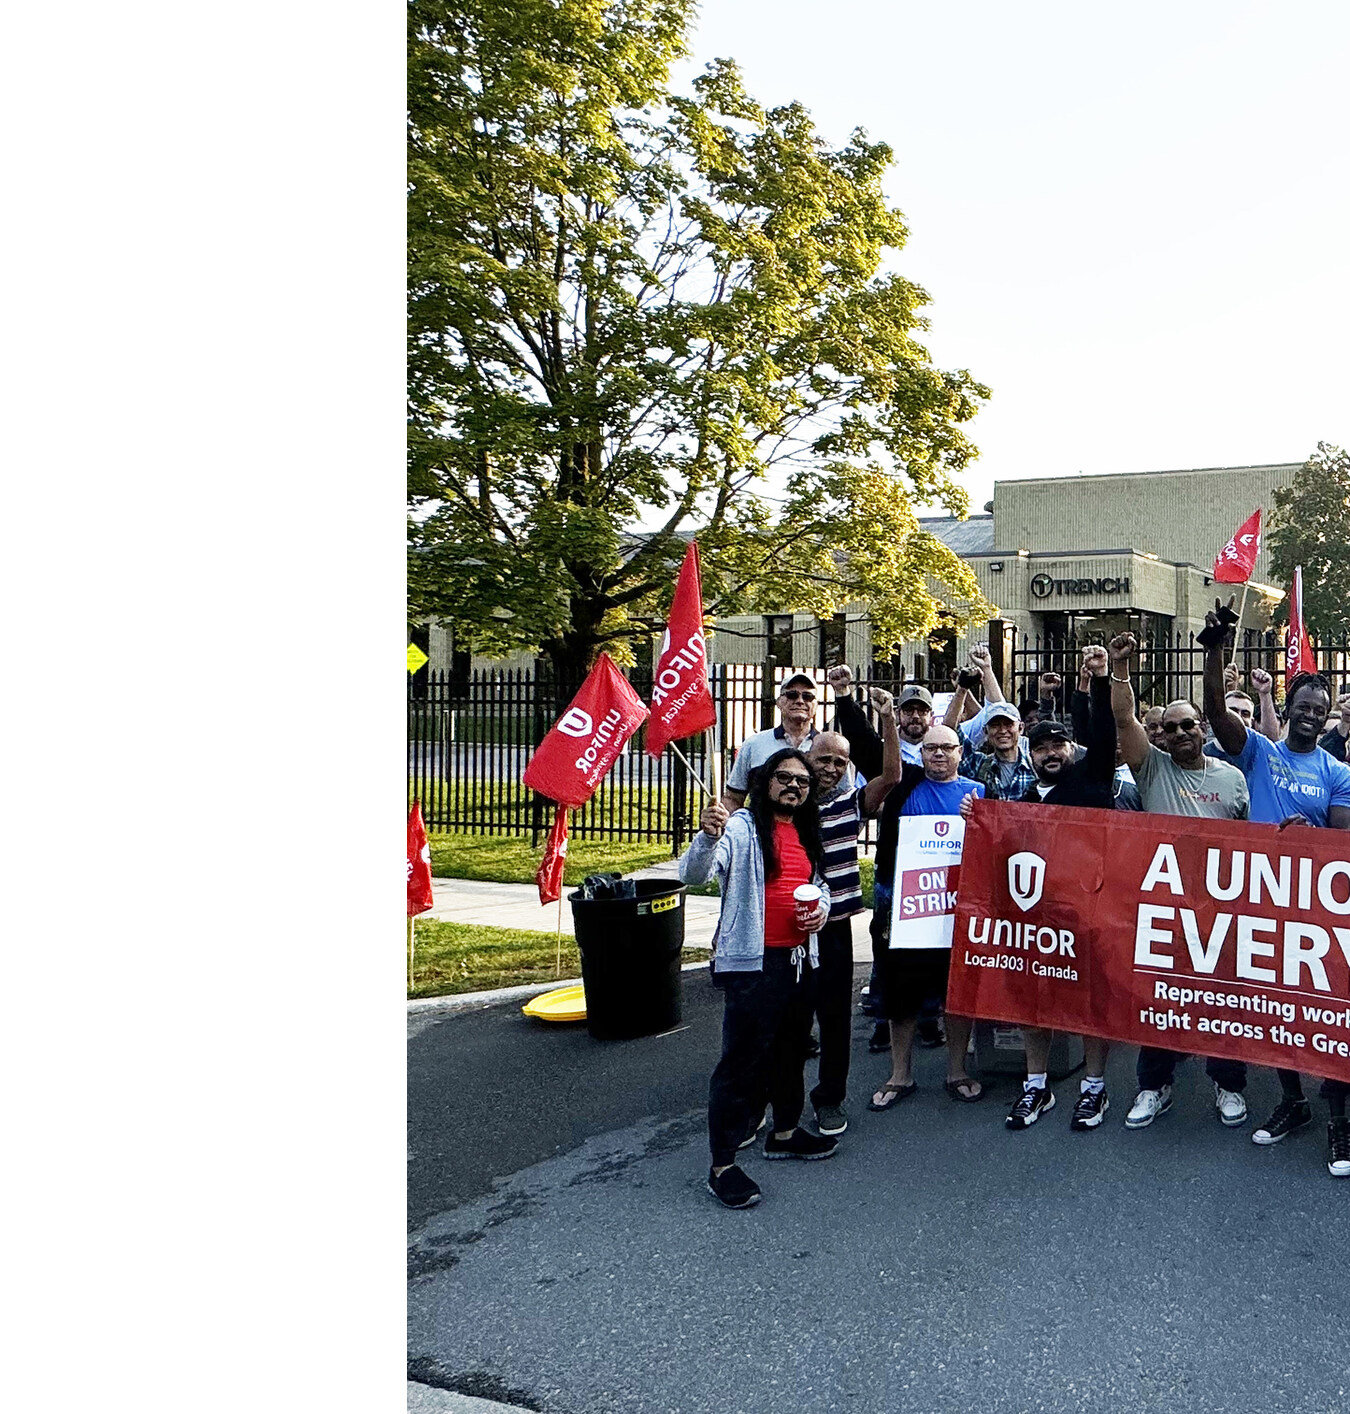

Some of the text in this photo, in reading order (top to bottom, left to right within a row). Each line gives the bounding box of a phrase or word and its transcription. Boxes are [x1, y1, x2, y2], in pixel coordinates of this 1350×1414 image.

[1054, 577, 1129, 595] TRENCH
[918, 871, 946, 891] ON
[1140, 843, 1184, 895] A
[902, 891, 958, 915] STRIK
[964, 951, 1078, 981] Local303 Canada
[1154, 981, 1296, 1022] Representing
[1140, 1007, 1191, 1030] right
[1197, 1017, 1264, 1040] across
[1270, 1025, 1306, 1047] the
